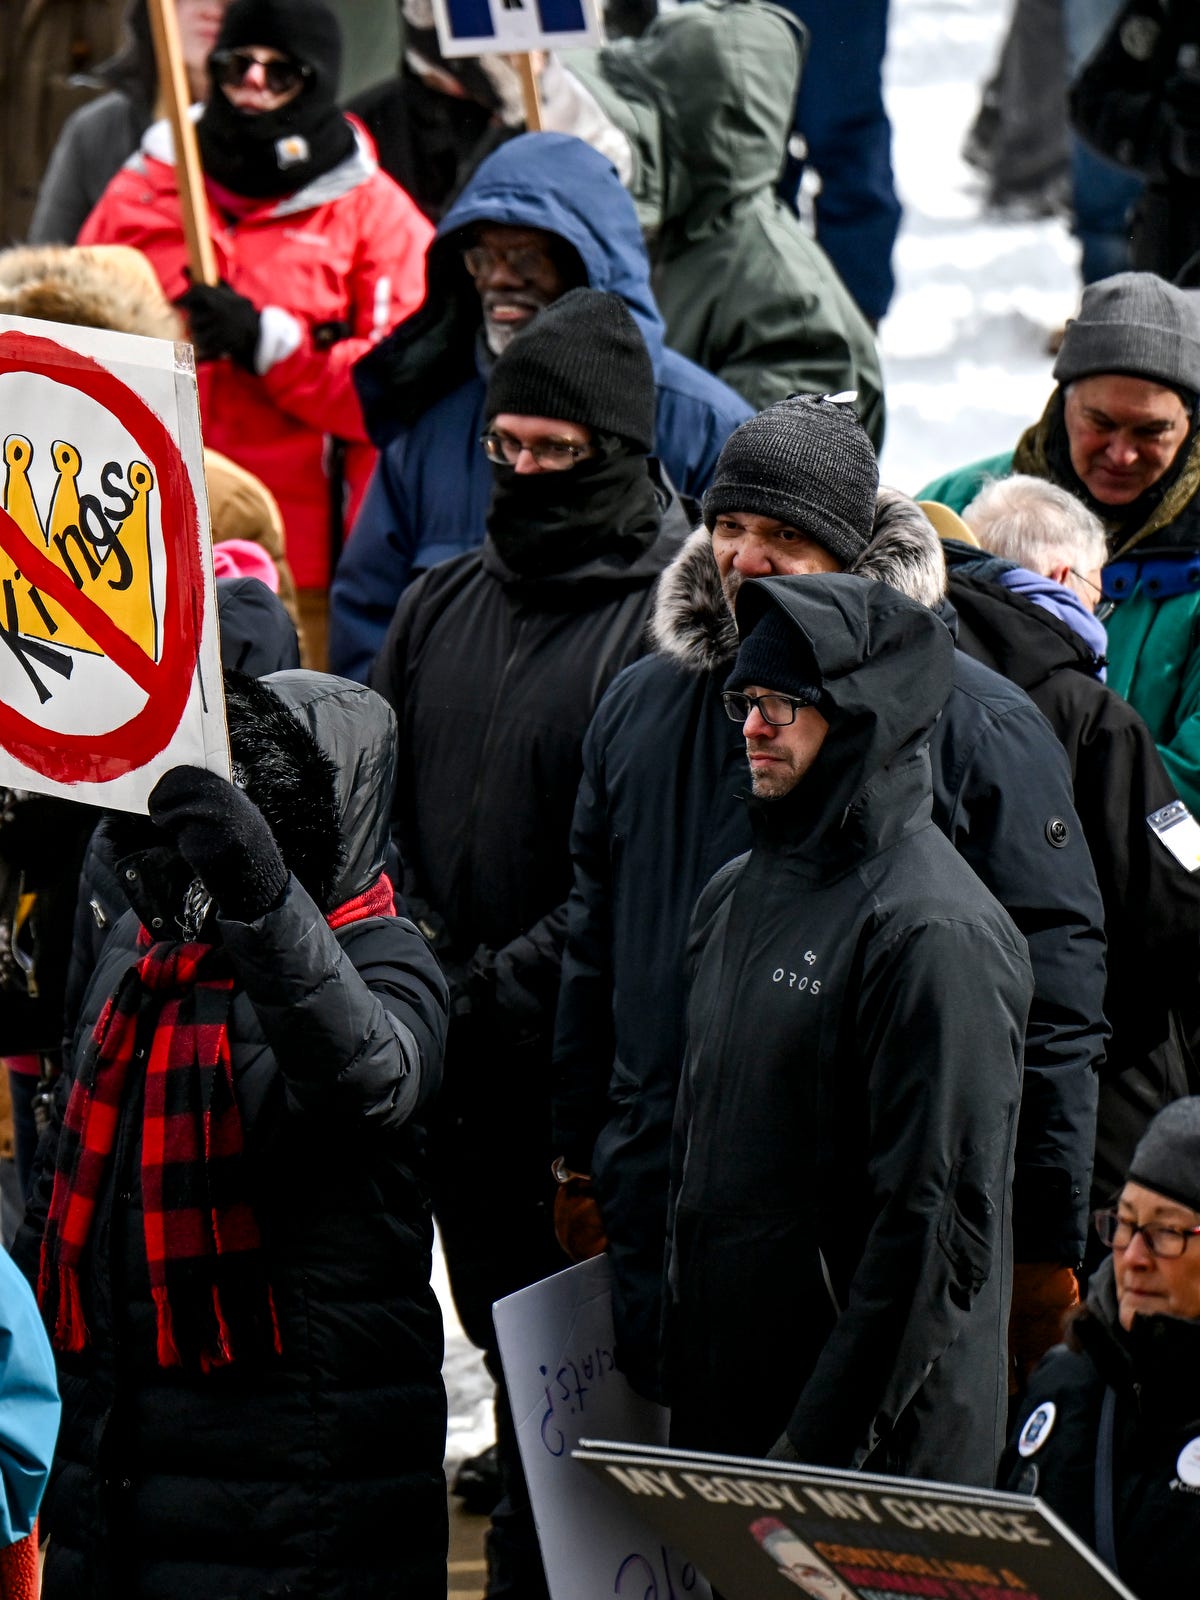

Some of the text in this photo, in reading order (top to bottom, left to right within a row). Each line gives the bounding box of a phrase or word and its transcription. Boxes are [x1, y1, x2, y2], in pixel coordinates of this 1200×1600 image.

[772, 967, 822, 995] OROS
[604, 1465, 686, 1499] MY
[681, 1473, 806, 1514] BODY
[802, 1486, 883, 1523] MY
[886, 1498, 1051, 1547] CHOICE
